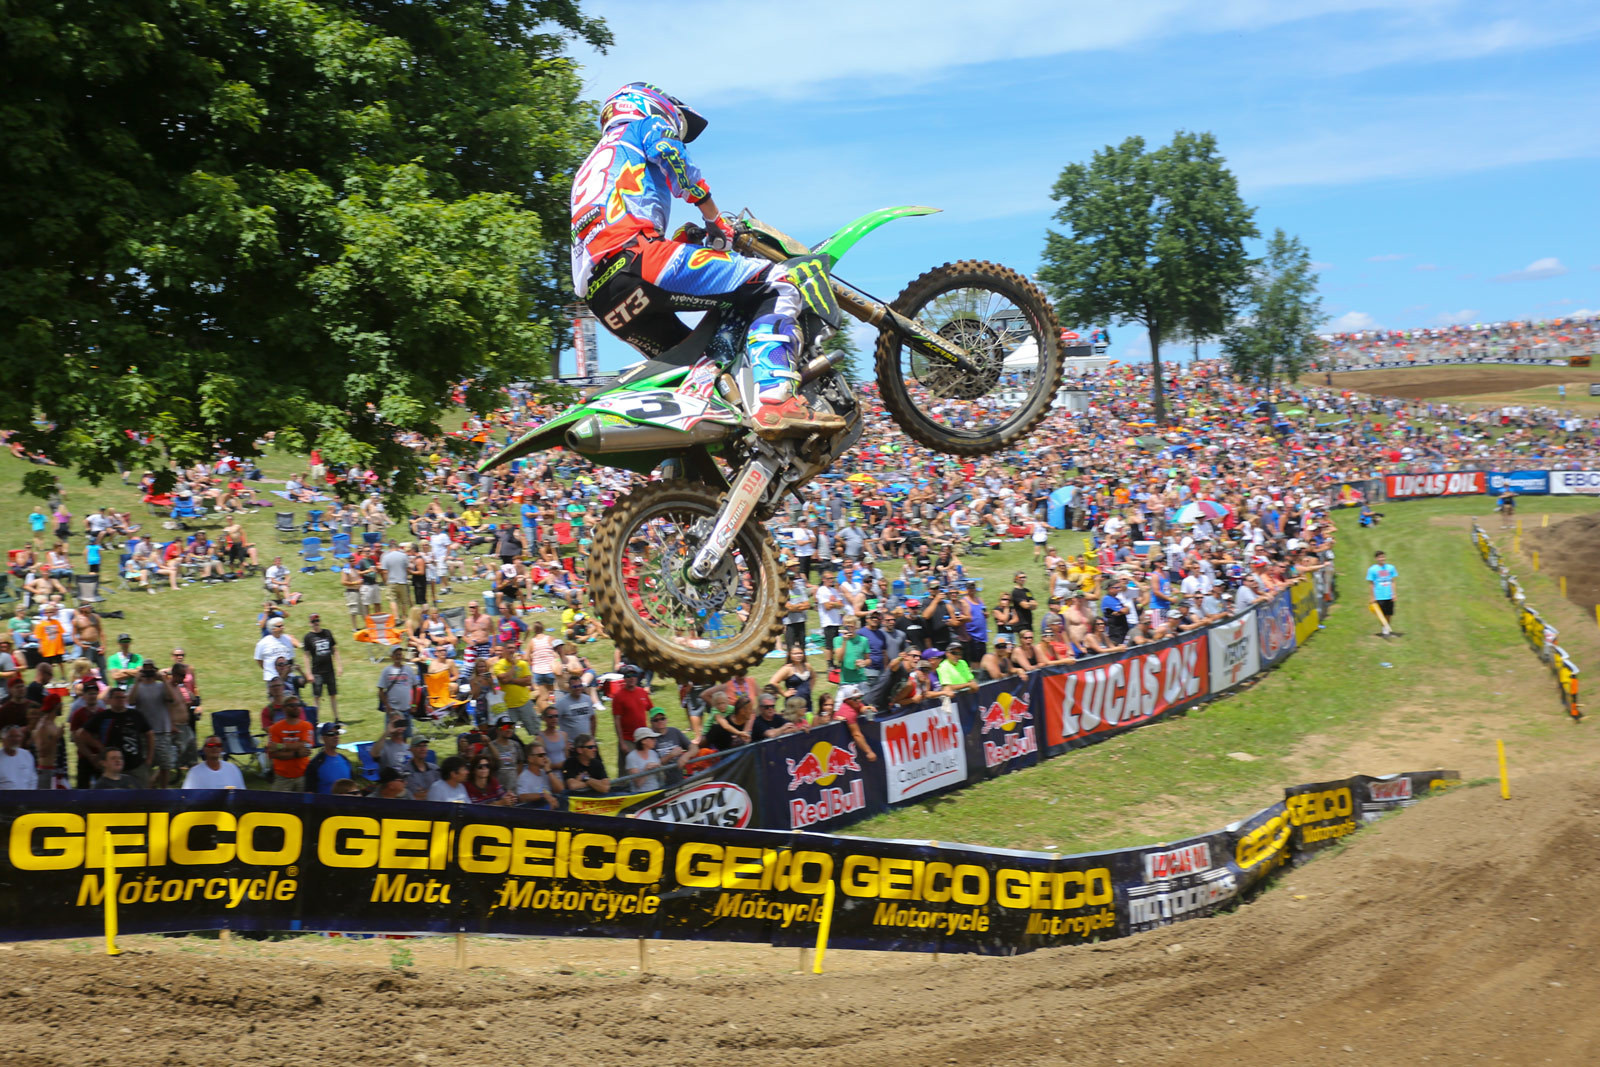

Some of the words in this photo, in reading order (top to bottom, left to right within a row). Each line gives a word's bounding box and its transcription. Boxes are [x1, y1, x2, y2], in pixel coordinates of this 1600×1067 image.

[604, 287, 651, 330] ET3
[670, 294, 718, 306] MONSTER
[622, 391, 682, 420] 3
[1394, 474, 1447, 496] LUCAS
[1447, 473, 1478, 493] OIL
[1062, 653, 1160, 738] LUCAS
[1163, 642, 1200, 705] OIL
[885, 716, 959, 766] Martin's
[899, 763, 926, 783] Count
[8, 811, 303, 870] GEICO
[318, 815, 455, 870] GEI
[458, 823, 665, 884] GEICO
[76, 871, 298, 908] Motorcycle
[499, 880, 661, 919] Motorcycle
[841, 854, 990, 906] GEICO
[996, 867, 1114, 909] GEICO
[872, 902, 990, 936] Motorcycle
